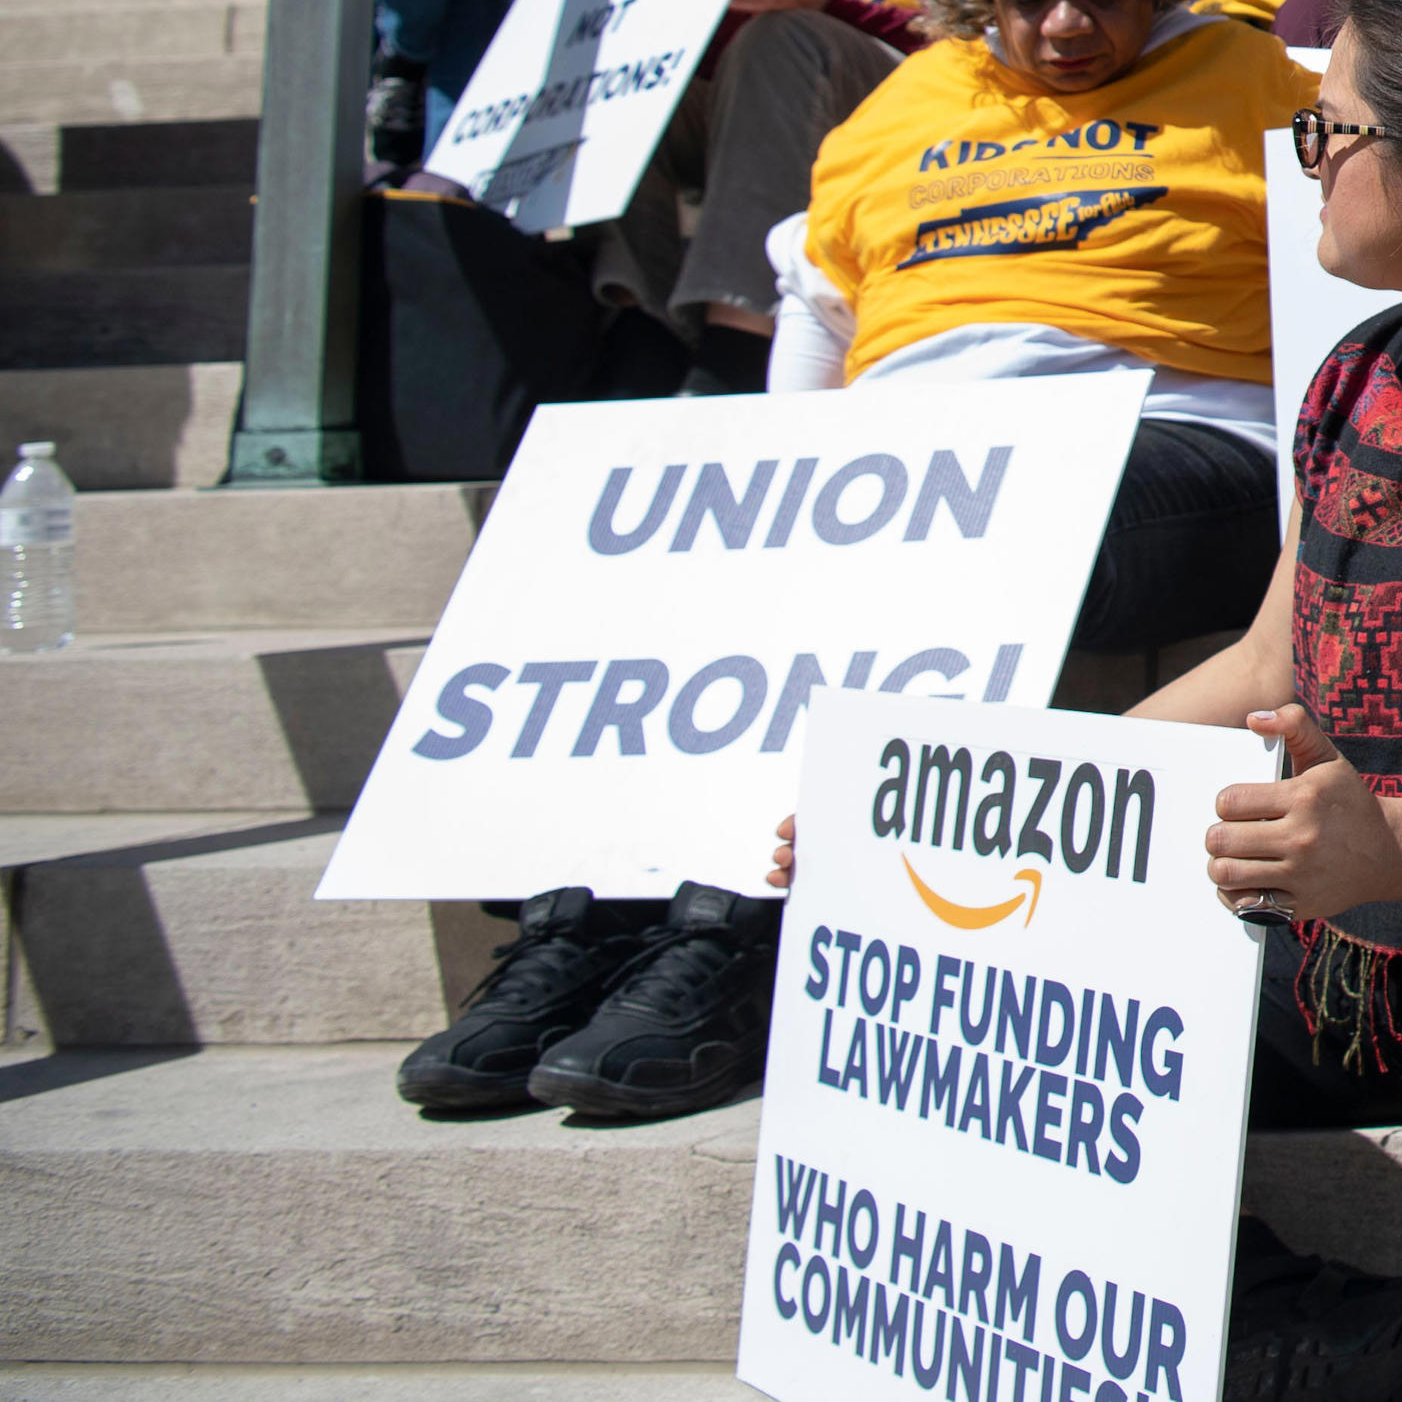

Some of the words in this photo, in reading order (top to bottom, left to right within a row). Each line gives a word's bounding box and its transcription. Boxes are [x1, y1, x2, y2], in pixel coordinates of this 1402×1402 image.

[452, 49, 685, 144] CORPORATIONS!
[1046, 119, 1159, 151] NOT
[908, 162, 1155, 210] CORPORATIONS
[920, 196, 1080, 254] TENNESSEE
[1078, 205, 1102, 222] for
[586, 445, 1015, 556] UNION
[872, 738, 1157, 884] amazon
[804, 925, 922, 1019] STOP
[929, 953, 1185, 1102] FUNDING
[817, 1008, 1145, 1185] LAWMAKERS
[774, 1153, 879, 1271] WHO
[889, 1202, 1042, 1343] HARM
[1055, 1269, 1188, 1402] OUR
